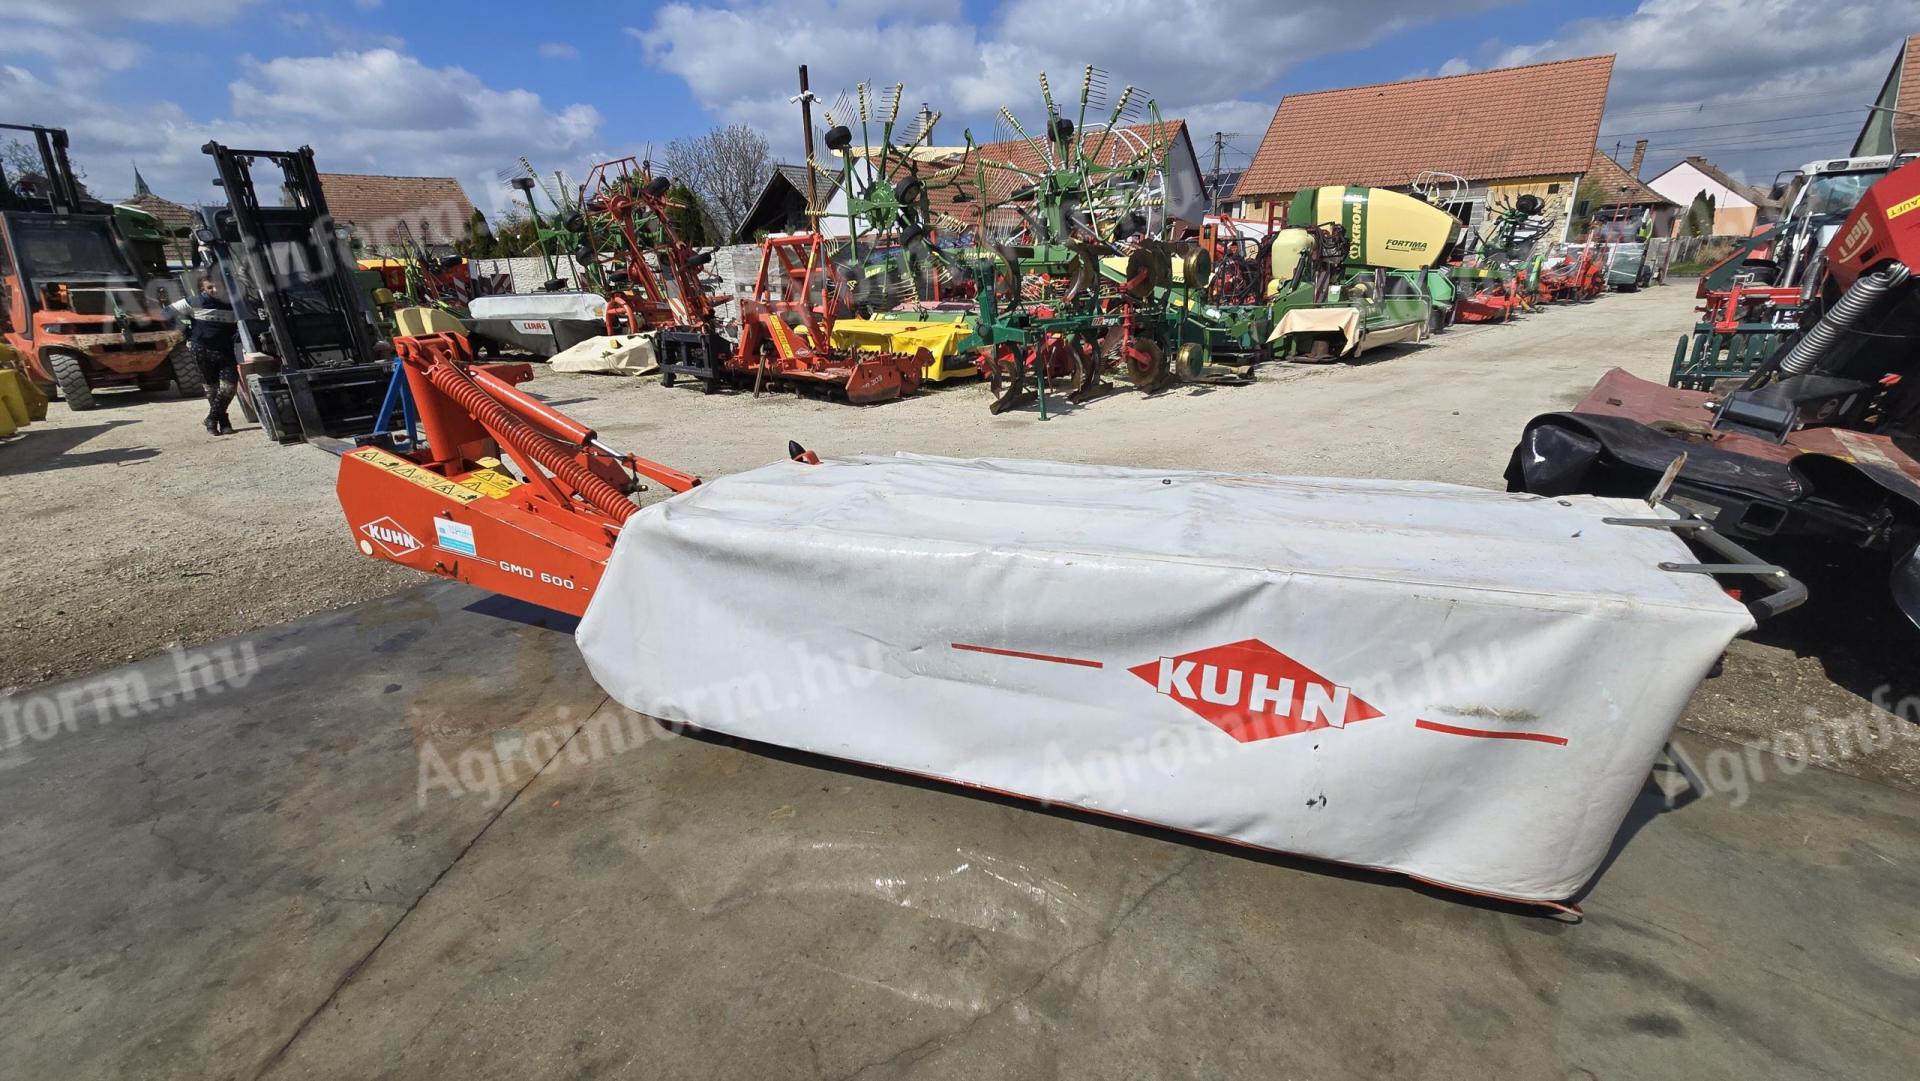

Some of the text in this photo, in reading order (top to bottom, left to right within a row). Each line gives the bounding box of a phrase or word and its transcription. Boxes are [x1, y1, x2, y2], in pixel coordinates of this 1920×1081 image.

[1351, 194, 1363, 244] KRONE
[1891, 196, 1920, 216] AUFT
[1385, 239, 1428, 249] FORTIMA
[523, 322, 547, 330] CLAAS
[368, 523, 416, 550] KUHN
[499, 560, 574, 590] GMD 600
[1157, 656, 1351, 730] KUHN
